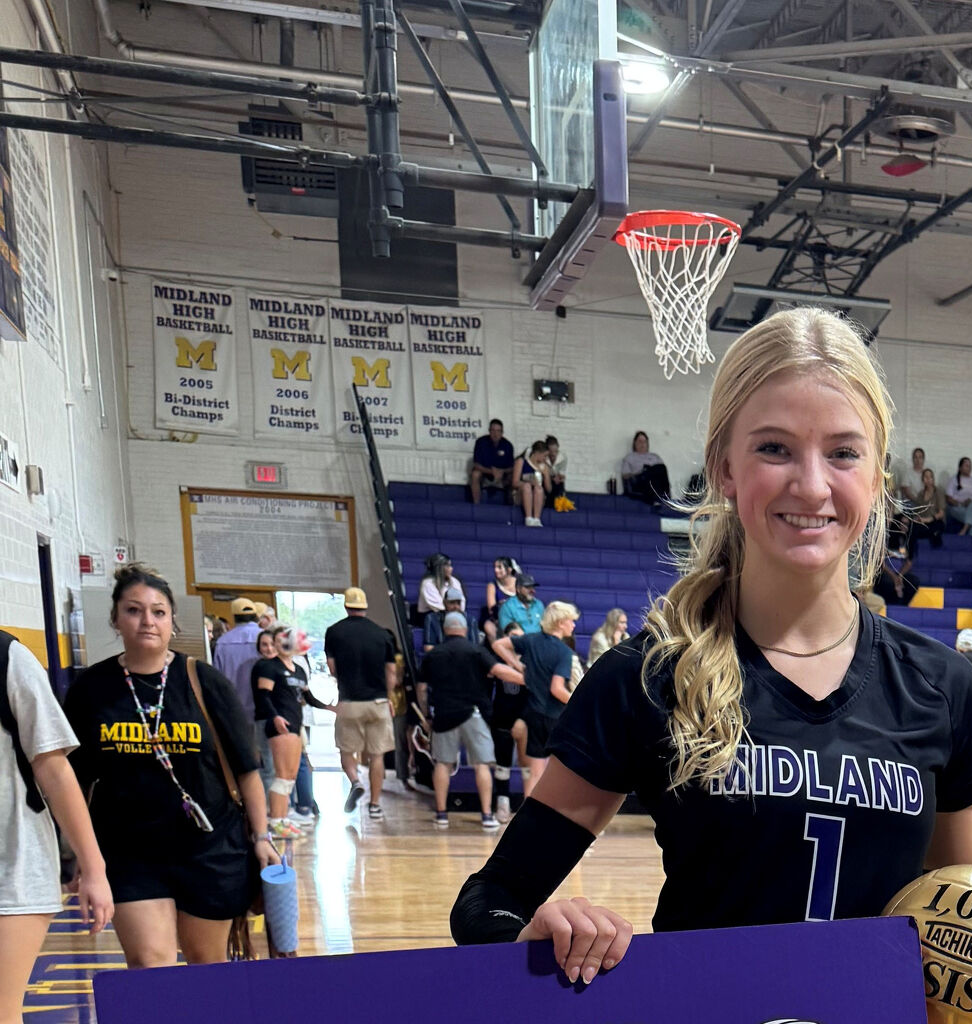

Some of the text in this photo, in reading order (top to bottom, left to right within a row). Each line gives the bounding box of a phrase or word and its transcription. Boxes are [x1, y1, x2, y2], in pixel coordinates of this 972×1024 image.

[154, 285, 232, 307] MIDLAND
[173, 303, 216, 320] HIGH
[250, 298, 325, 317] MIDLAND
[331, 307, 404, 324] MIDLAND
[156, 317, 233, 335] BASKETBALL
[268, 315, 310, 331] HIGH
[410, 313, 481, 329] MIDLAND
[252, 329, 327, 345] BASKETBALL
[349, 324, 389, 338] HIGH
[428, 330, 466, 343] HIGH
[333, 337, 405, 352] BASKETBALL
[413, 343, 483, 356] BASKETBALL
[175, 337, 217, 371] M
[270, 348, 312, 382] M
[351, 356, 392, 388] M
[180, 377, 213, 389] 2005
[430, 360, 470, 392] M
[164, 393, 230, 409] Bi-District
[276, 388, 309, 400] 2006
[270, 405, 316, 418] District
[436, 400, 467, 410] 2008
[171, 405, 224, 422] Champs
[343, 411, 404, 425] Bi-istrict
[269, 416, 319, 432] Champs
[423, 416, 482, 428] Bi-District
[350, 424, 399, 438] Cmps
[429, 428, 477, 442] Champs
[100, 722, 202, 744] MIDLAND
[115, 743, 186, 754] VOLLEALL
[709, 744, 923, 816] MIDLAND
[803, 812, 846, 922] 1
